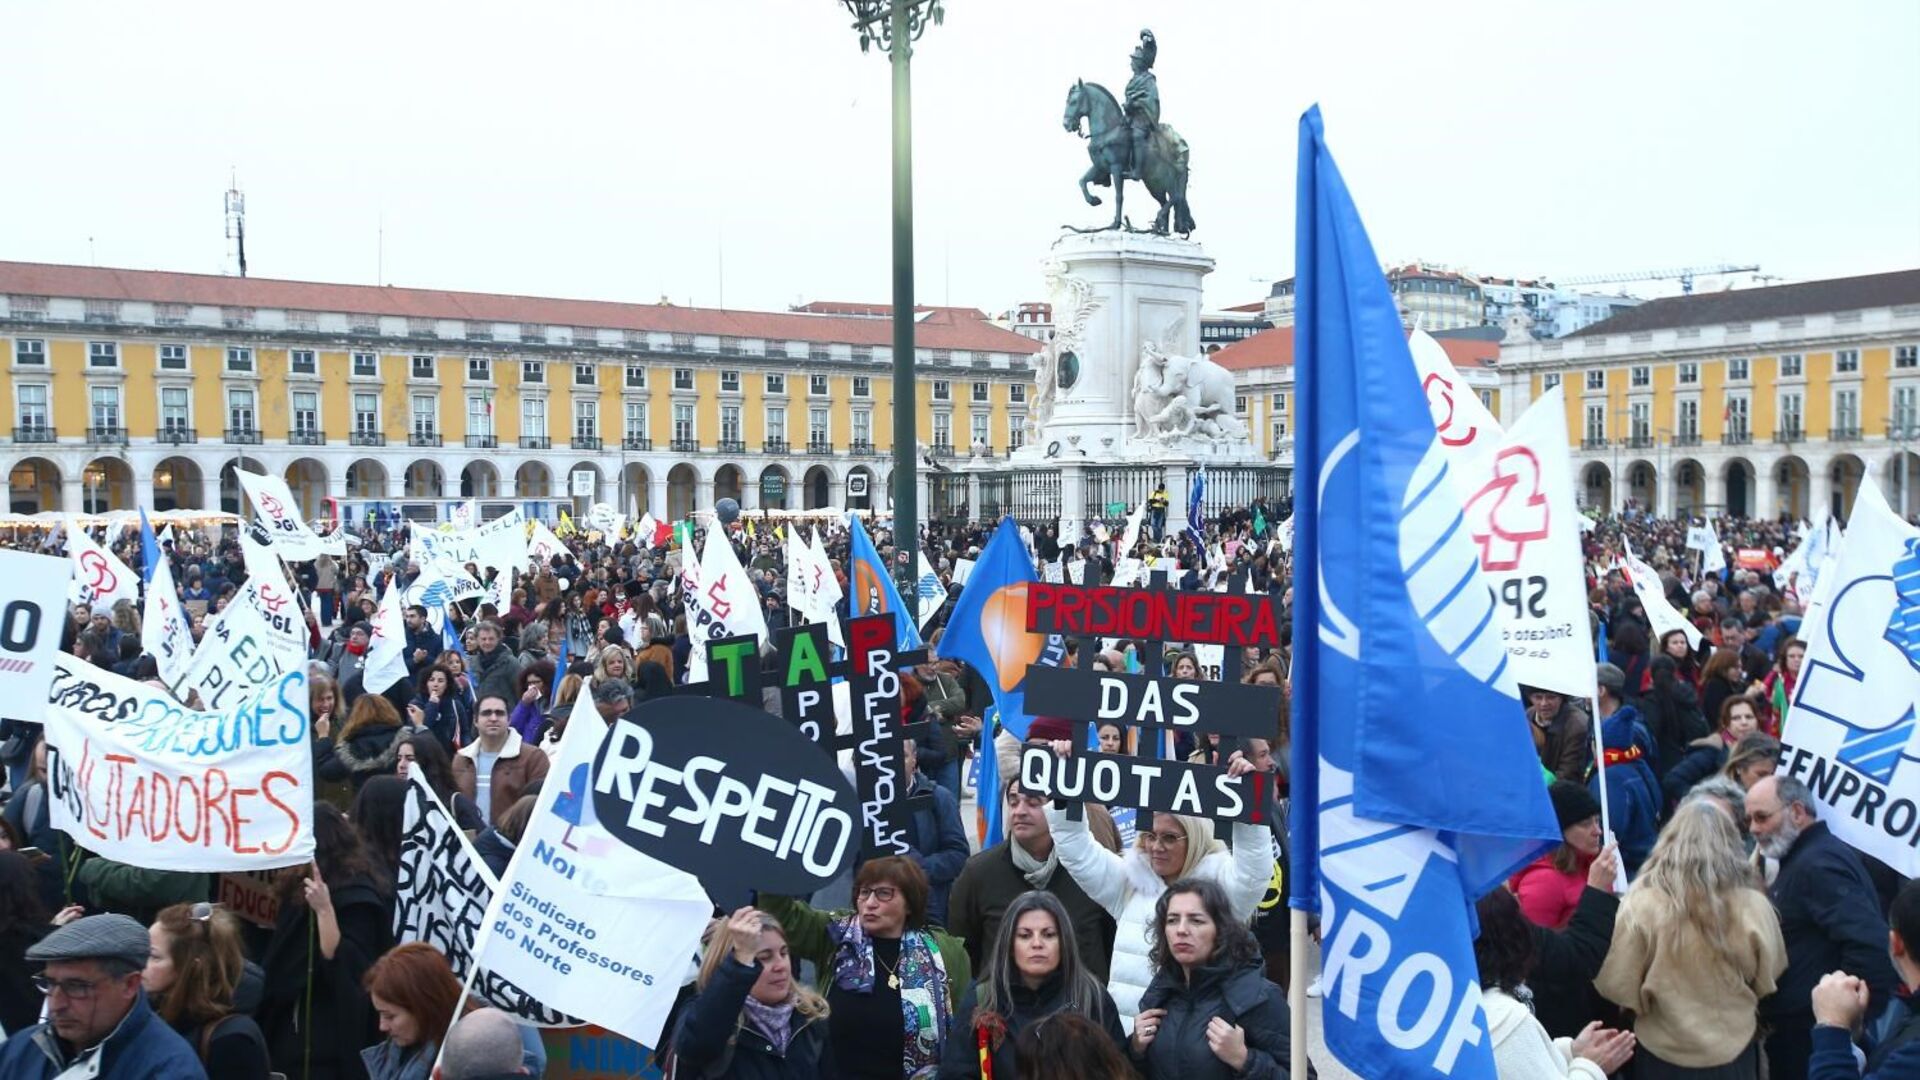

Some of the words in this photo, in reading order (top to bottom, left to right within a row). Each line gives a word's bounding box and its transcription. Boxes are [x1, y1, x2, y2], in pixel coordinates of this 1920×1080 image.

[1098, 677, 1200, 726] DAS
[594, 717, 853, 878] RESPEITO
[511, 881, 597, 940] Sindicato
[493, 920, 516, 940] do
[519, 934, 573, 975] Norte
[502, 902, 535, 929] dos
[537, 921, 655, 987] Professores
